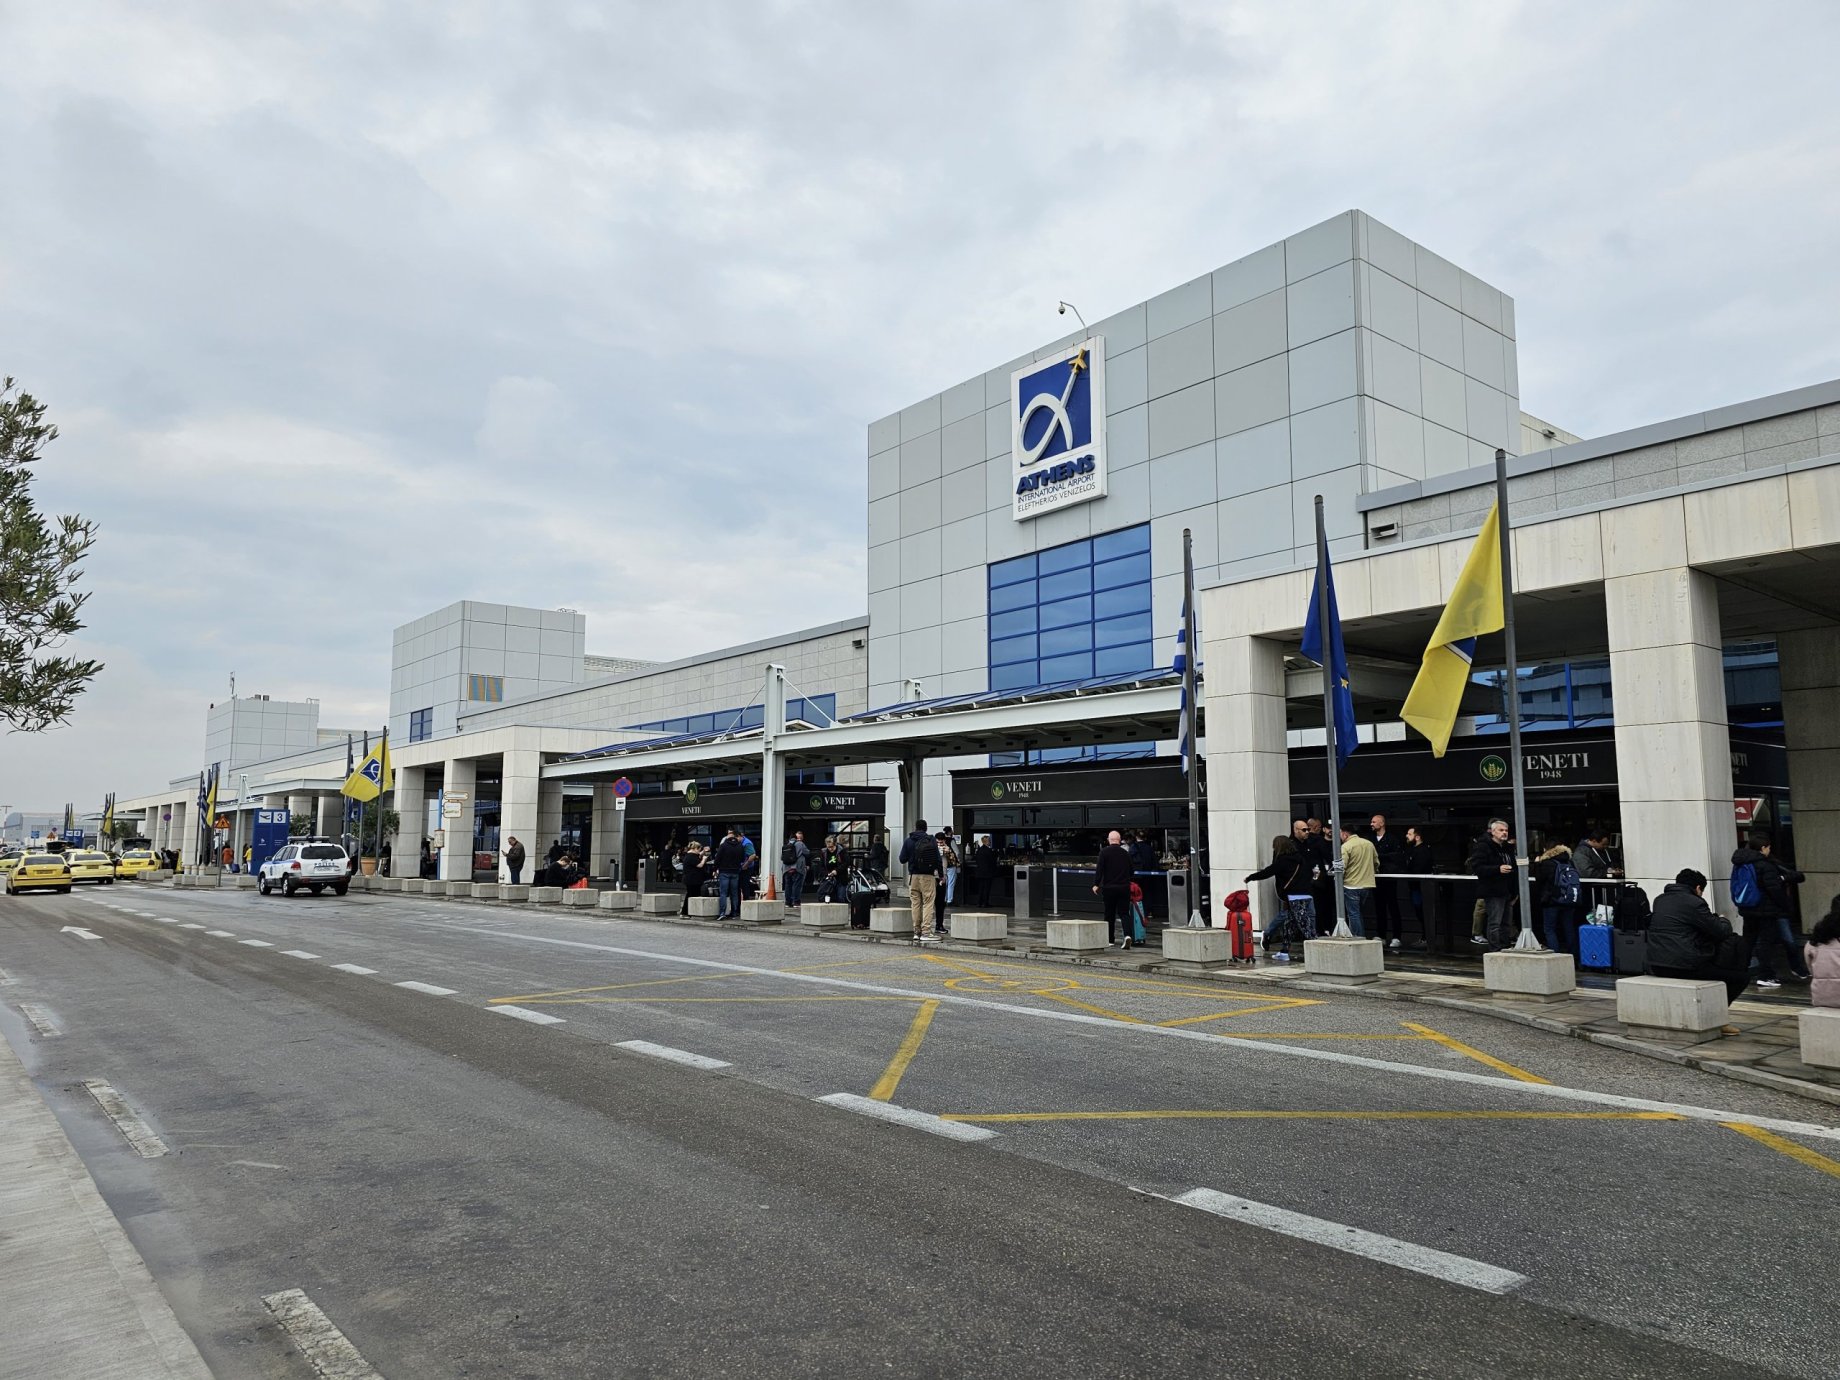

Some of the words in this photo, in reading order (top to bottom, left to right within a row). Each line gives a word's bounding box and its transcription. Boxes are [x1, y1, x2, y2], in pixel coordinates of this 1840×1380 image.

[1016, 454, 1095, 494] ATHENS
[1017, 483, 1066, 503] INTERNATIONAL
[1067, 473, 1095, 489] AIRPORT
[1017, 494, 1058, 513] ELEFTHERIOS
[1059, 482, 1096, 500] VENIZELOS
[1521, 752, 1590, 770] ENETI
[1540, 770, 1562, 779] 1948
[1006, 781, 1042, 793] VENETI
[824, 796, 856, 806] VENETI
[681, 806, 702, 815] VENETI
[277, 813, 283, 822] 3
